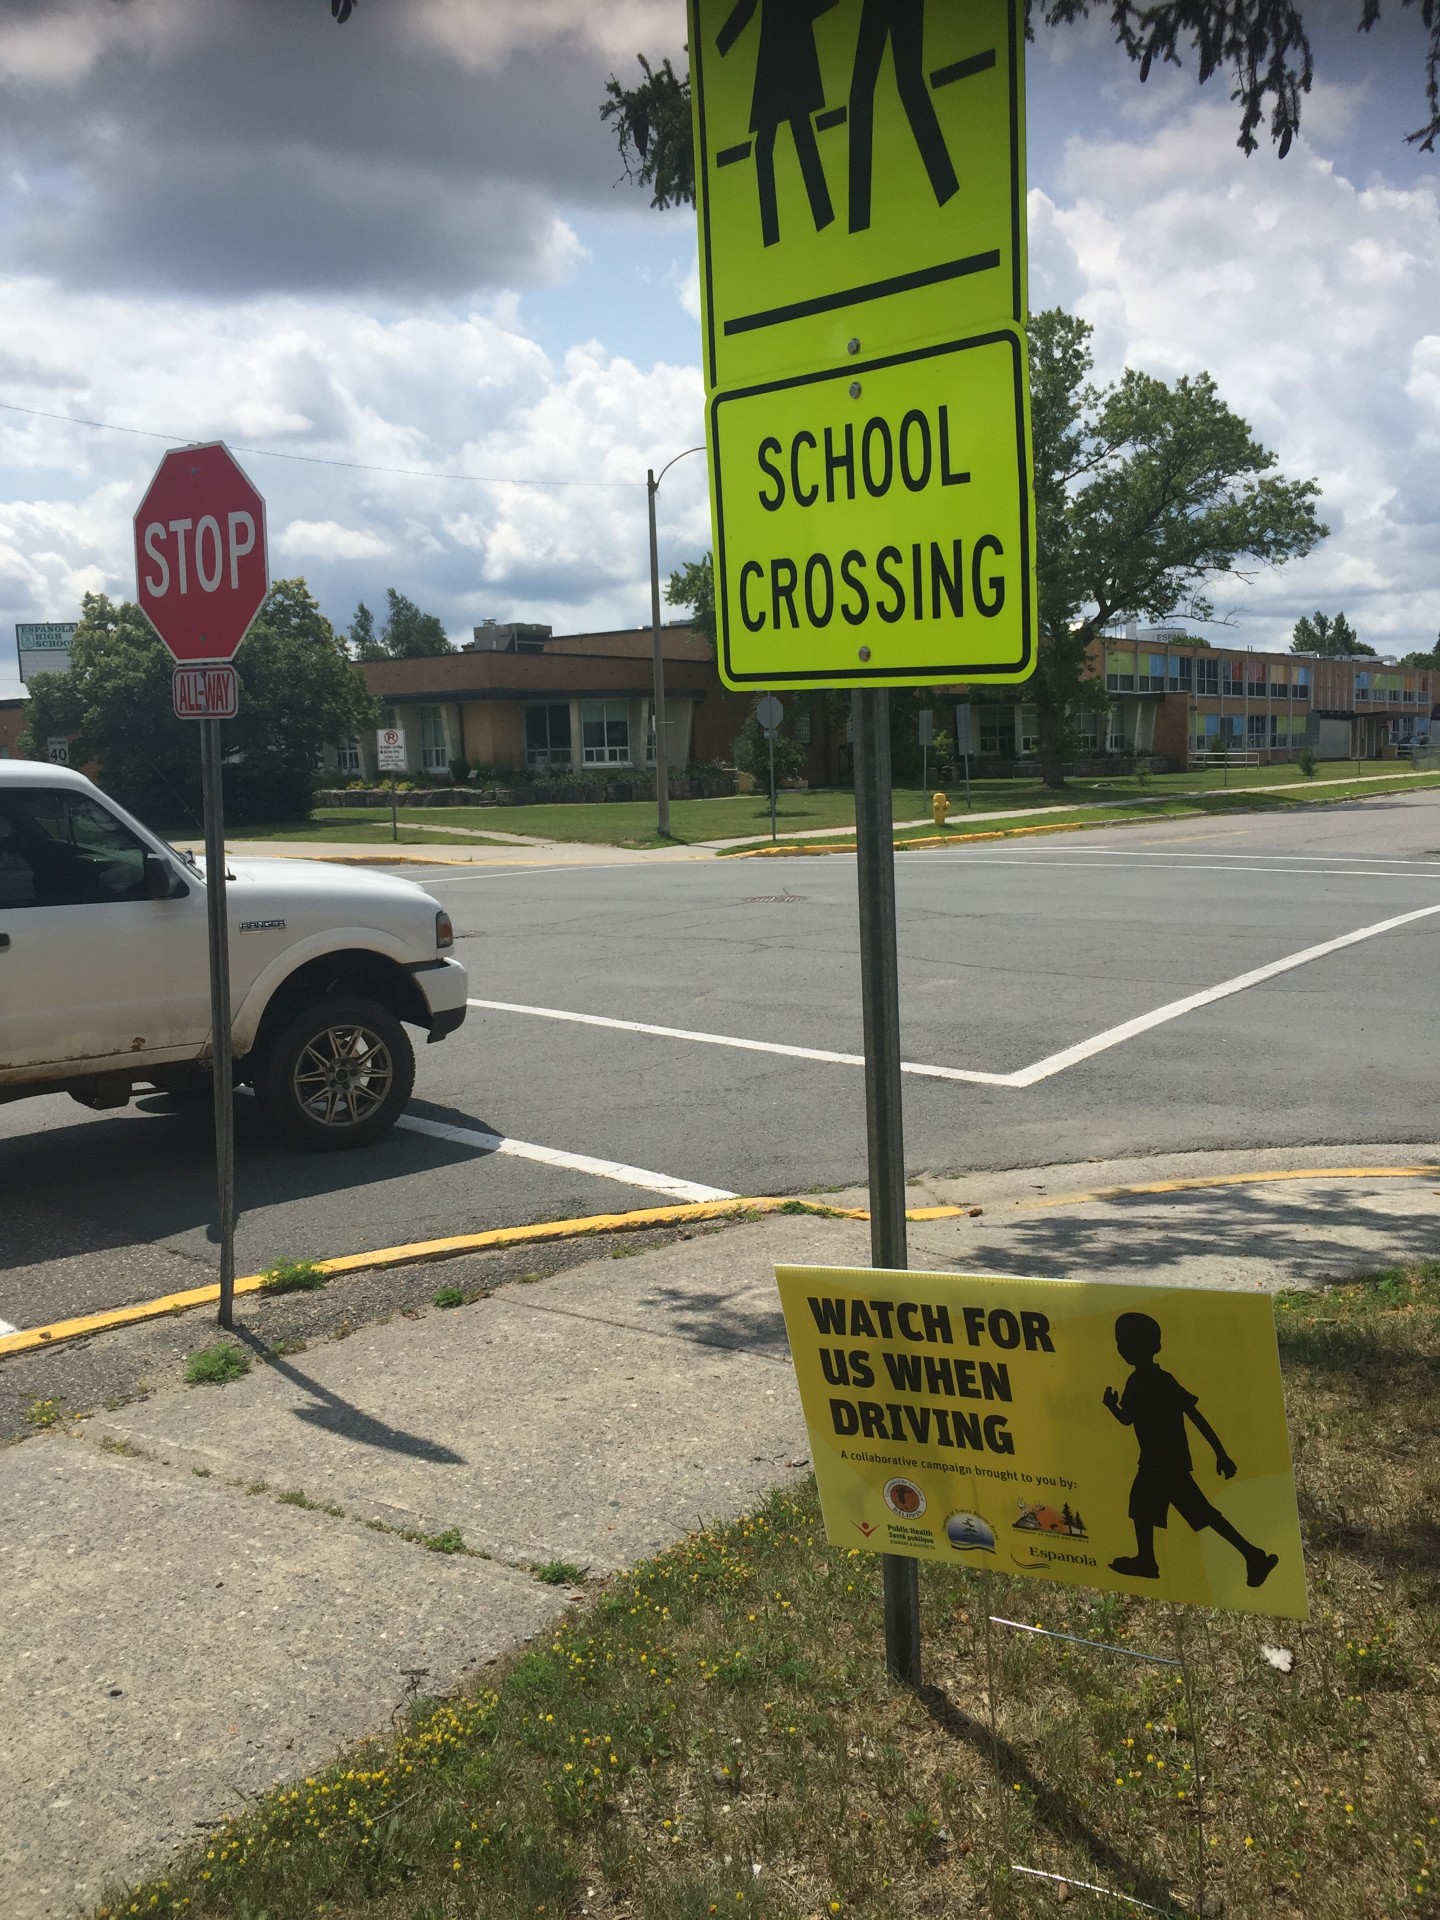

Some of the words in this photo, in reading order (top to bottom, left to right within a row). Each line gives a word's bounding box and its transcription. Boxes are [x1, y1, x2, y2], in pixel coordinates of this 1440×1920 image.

[757, 405, 971, 512] SCHOOL
[144, 510, 256, 598] STOP
[739, 534, 1005, 632] CROSSING
[20, 625, 75, 633] ESPANOLA
[1157, 633, 1176, 641] ESP
[179, 673, 230, 711] ALL-WAY
[50, 748, 67, 761] 40
[240, 920, 286, 929] RANGER
[807, 1296, 954, 1344] WATCH
[962, 1307, 1056, 1353] FOR
[819, 1348, 875, 1388] US
[882, 1352, 1013, 1402] WHEN
[828, 1398, 1016, 1455] DRIVING
[841, 1452, 848, 1460] A
[851, 1452, 918, 1468] collaborative
[921, 1459, 972, 1475] campaign
[975, 1465, 1018, 1481] brought
[1021, 1473, 1033, 1483] to
[1036, 1476, 1056, 1487] you
[1060, 1477, 1078, 1490] by:
[887, 1524, 909, 1533] Public
[910, 1528, 933, 1537] Health
[908, 1535, 934, 1544] publique
[1029, 1546, 1098, 1567] Espanola
